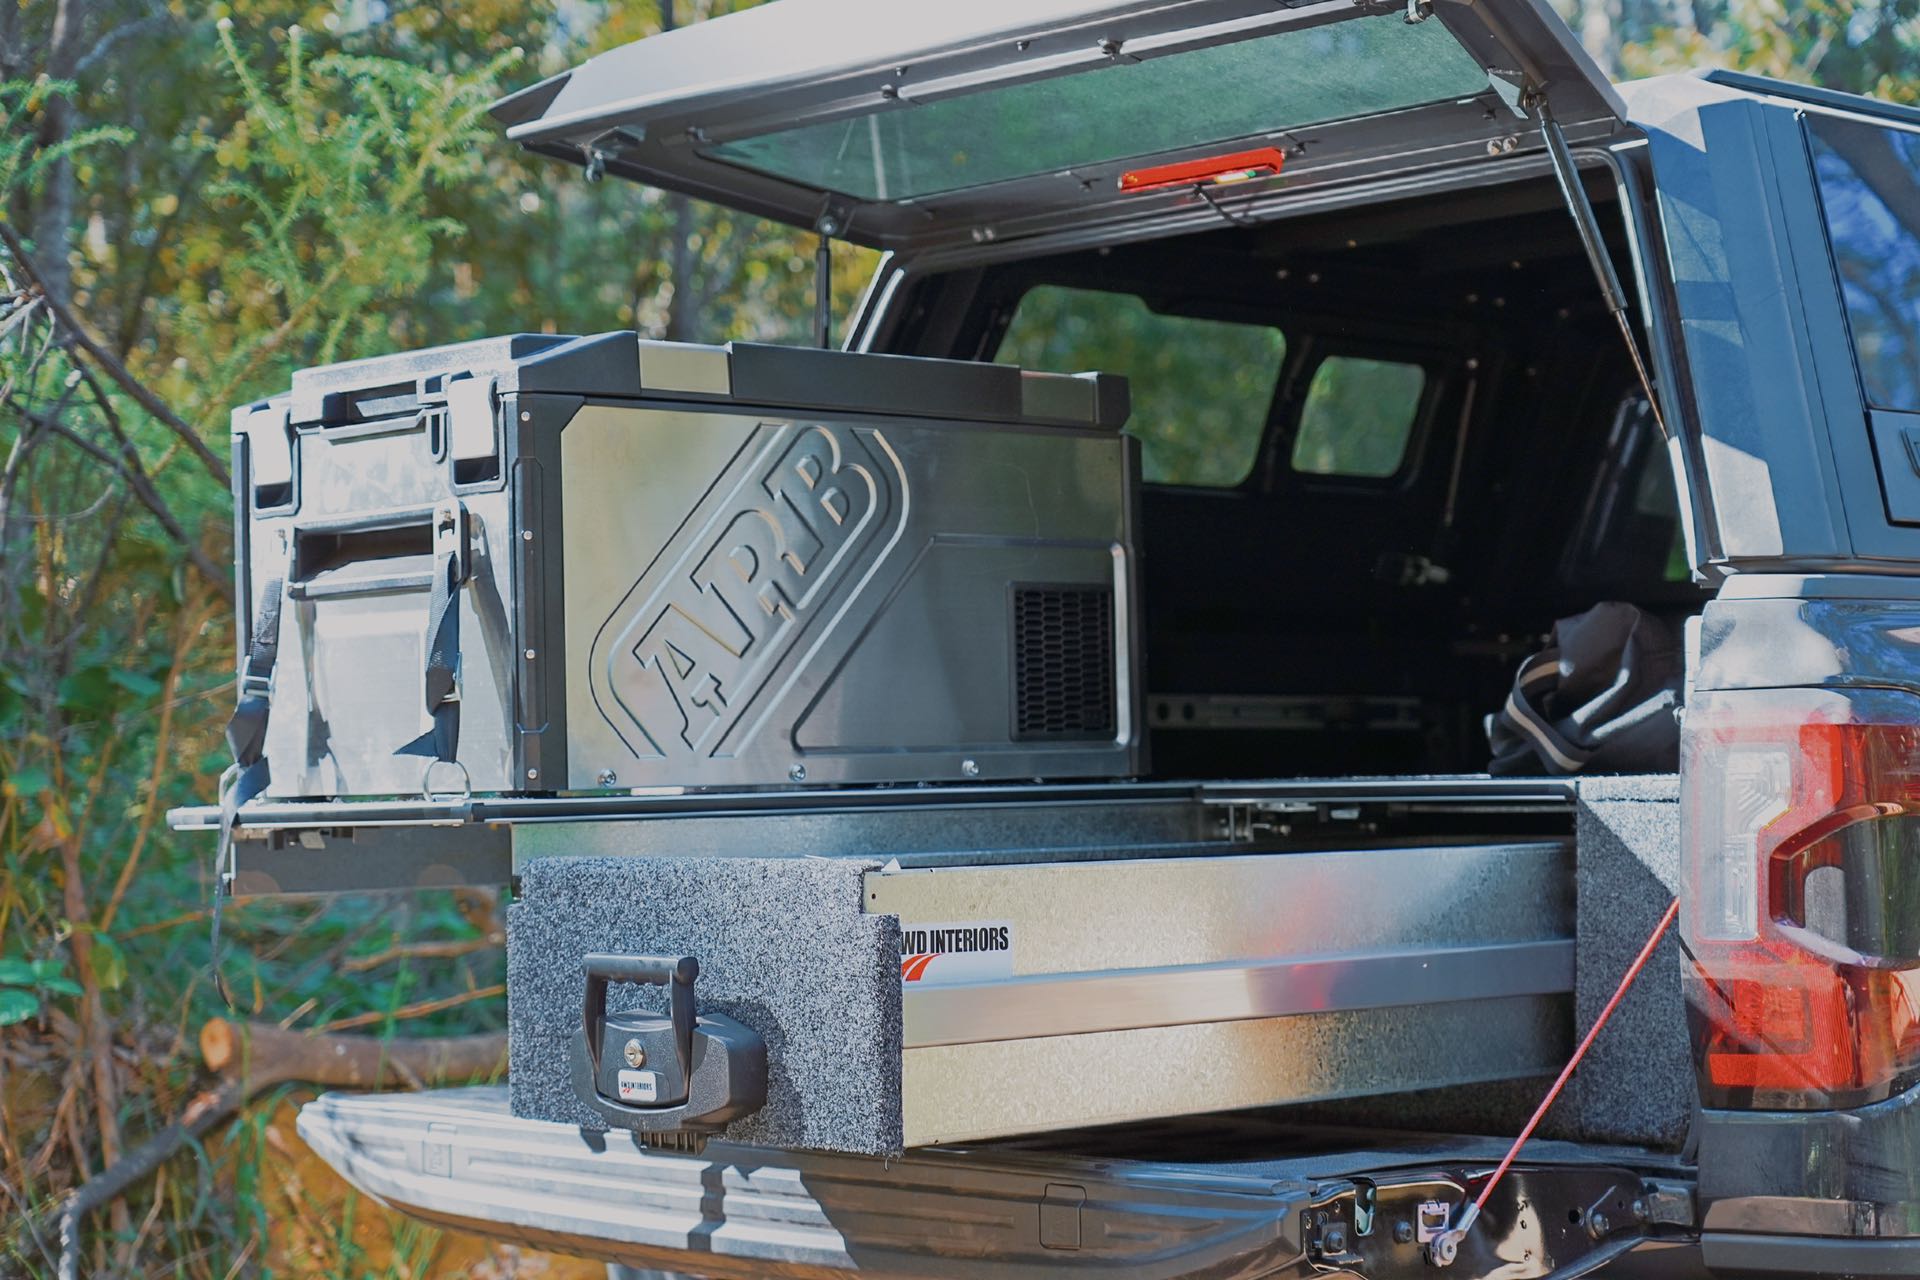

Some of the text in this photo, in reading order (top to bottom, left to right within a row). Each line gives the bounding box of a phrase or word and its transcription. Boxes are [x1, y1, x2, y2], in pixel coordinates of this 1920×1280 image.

[632, 426, 877, 752] ARB
[901, 926, 1009, 955] WD INTERIORS
